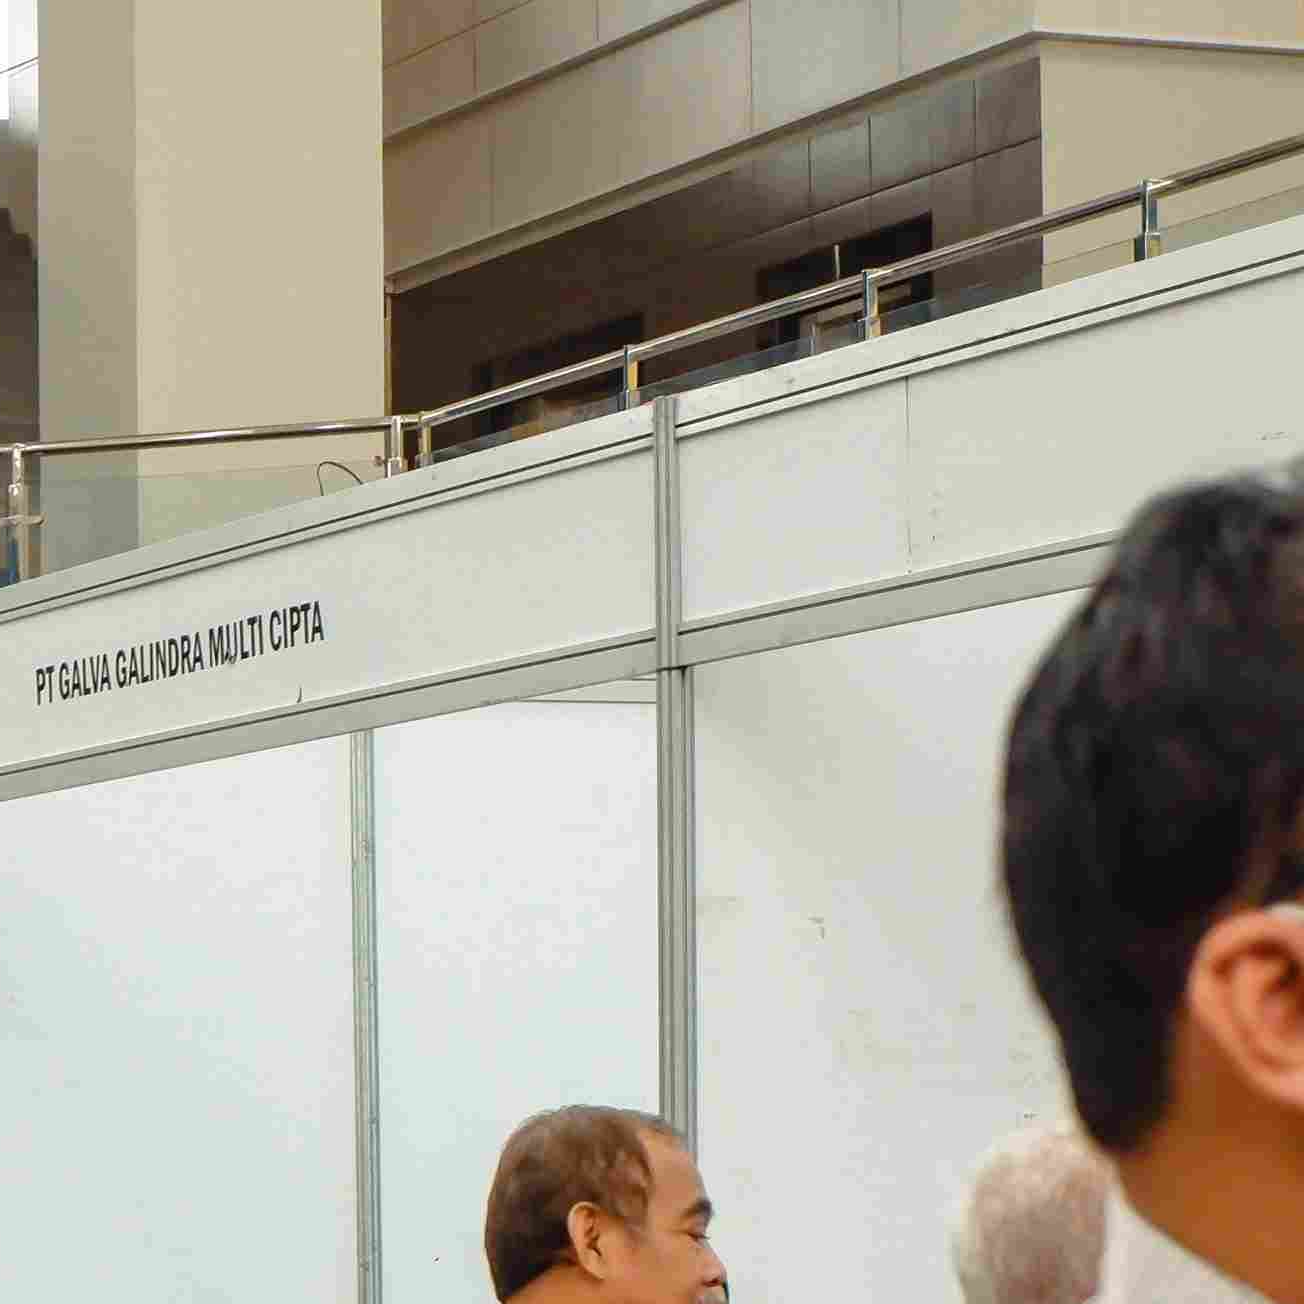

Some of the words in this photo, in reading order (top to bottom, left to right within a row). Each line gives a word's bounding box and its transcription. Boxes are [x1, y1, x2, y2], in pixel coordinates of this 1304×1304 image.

[35, 665, 55, 706] PT
[59, 654, 111, 700] GALVA
[115, 632, 204, 690] GALINDRA
[208, 615, 264, 668] MULTI
[269, 600, 325, 652] CIPTA
